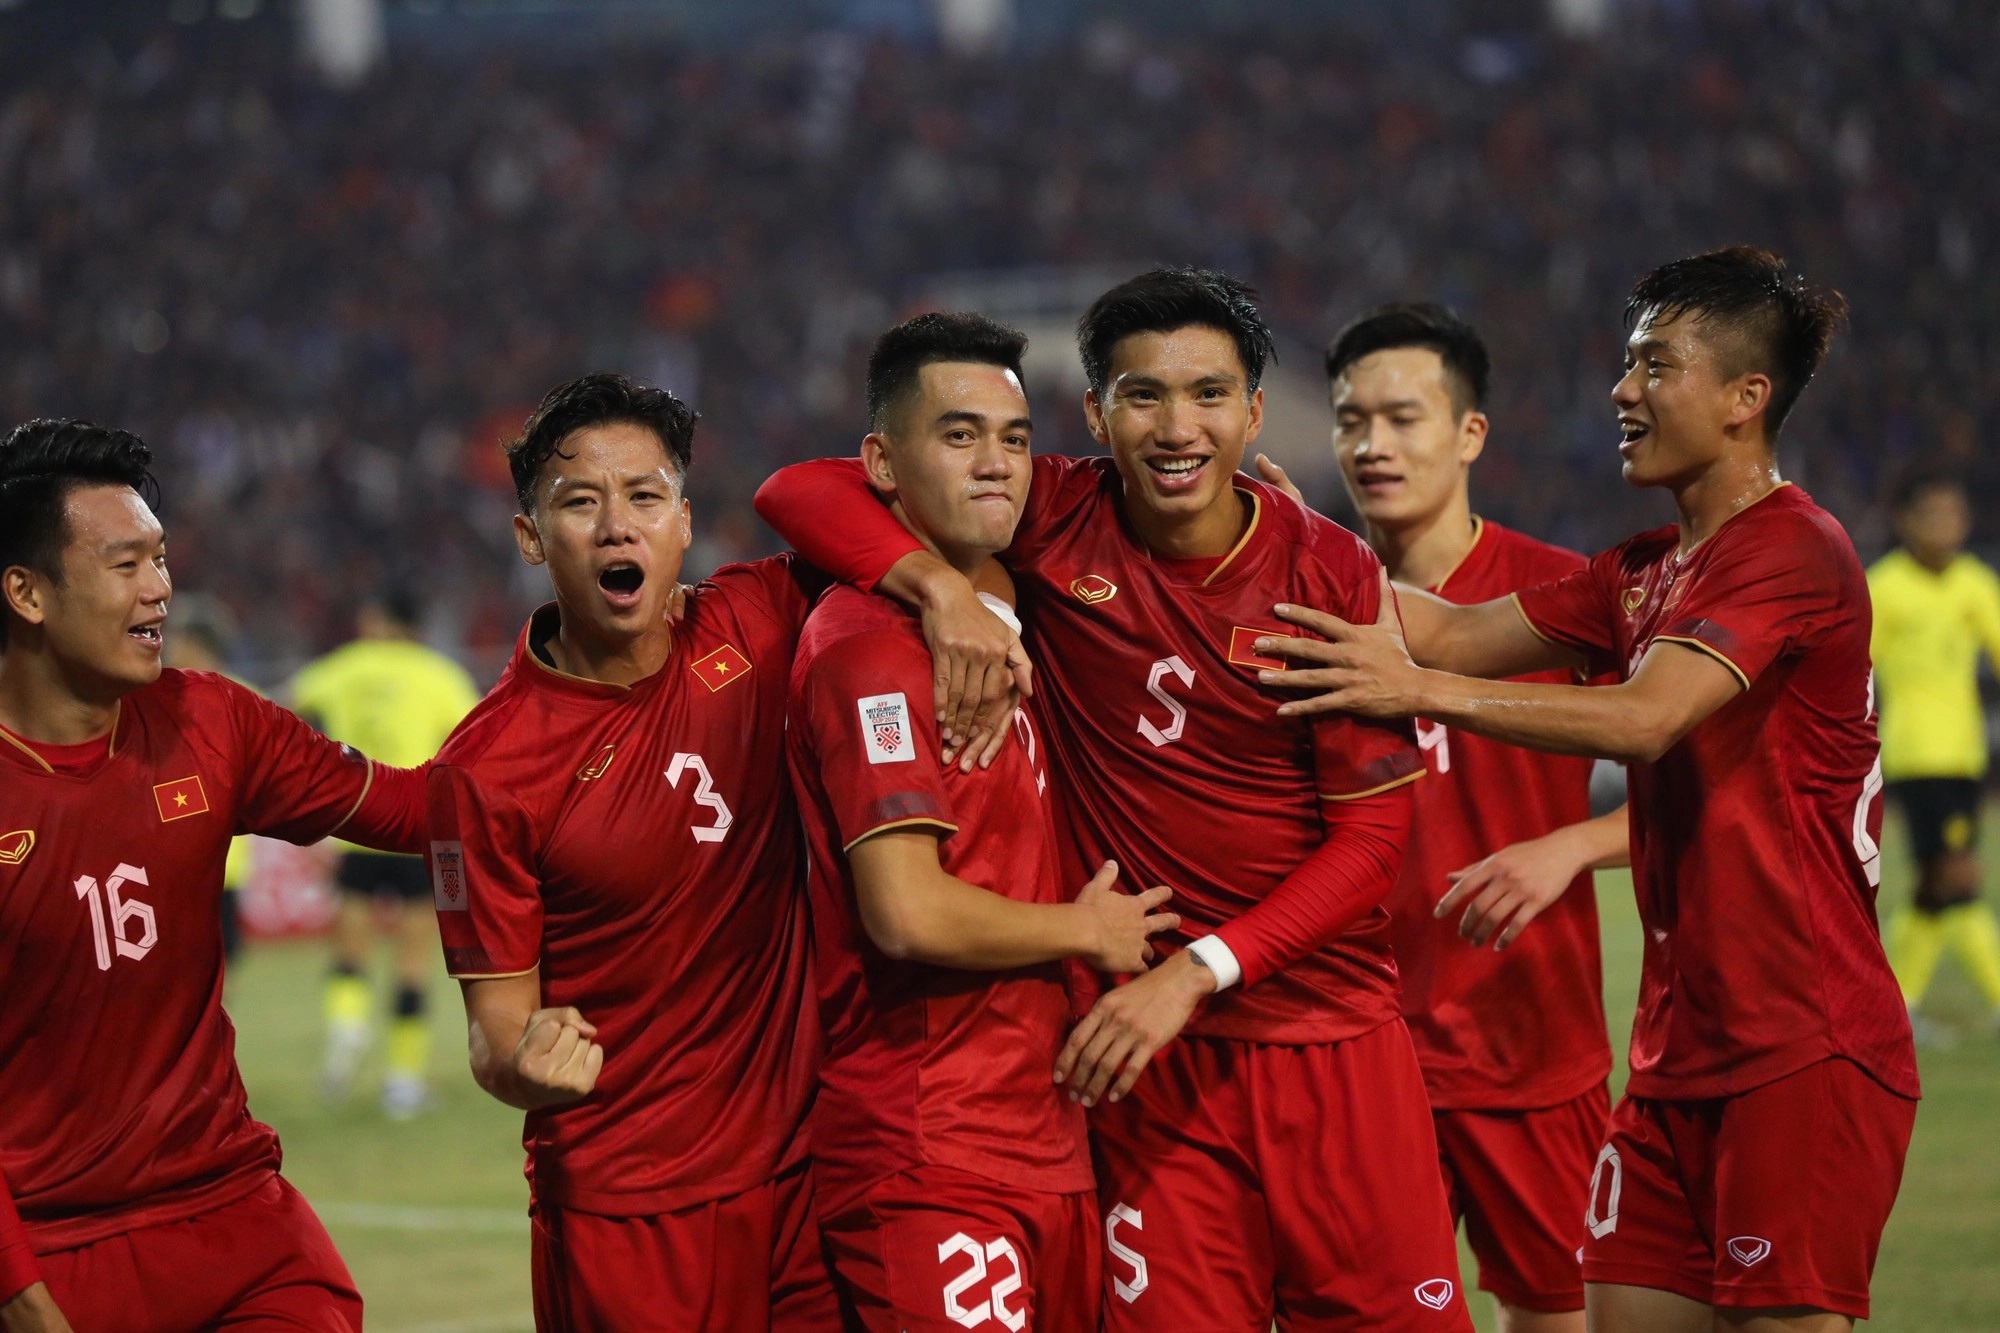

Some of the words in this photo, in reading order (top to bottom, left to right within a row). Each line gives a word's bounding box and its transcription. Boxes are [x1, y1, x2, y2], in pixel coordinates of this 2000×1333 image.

[866, 705, 901, 714] MITSUBISHI
[868, 710, 899, 719] ELECTRIC
[663, 752, 734, 845] 3
[73, 862, 158, 972] 16
[1584, 1142, 1622, 1240] 0
[937, 1231, 1026, 1333] 22
